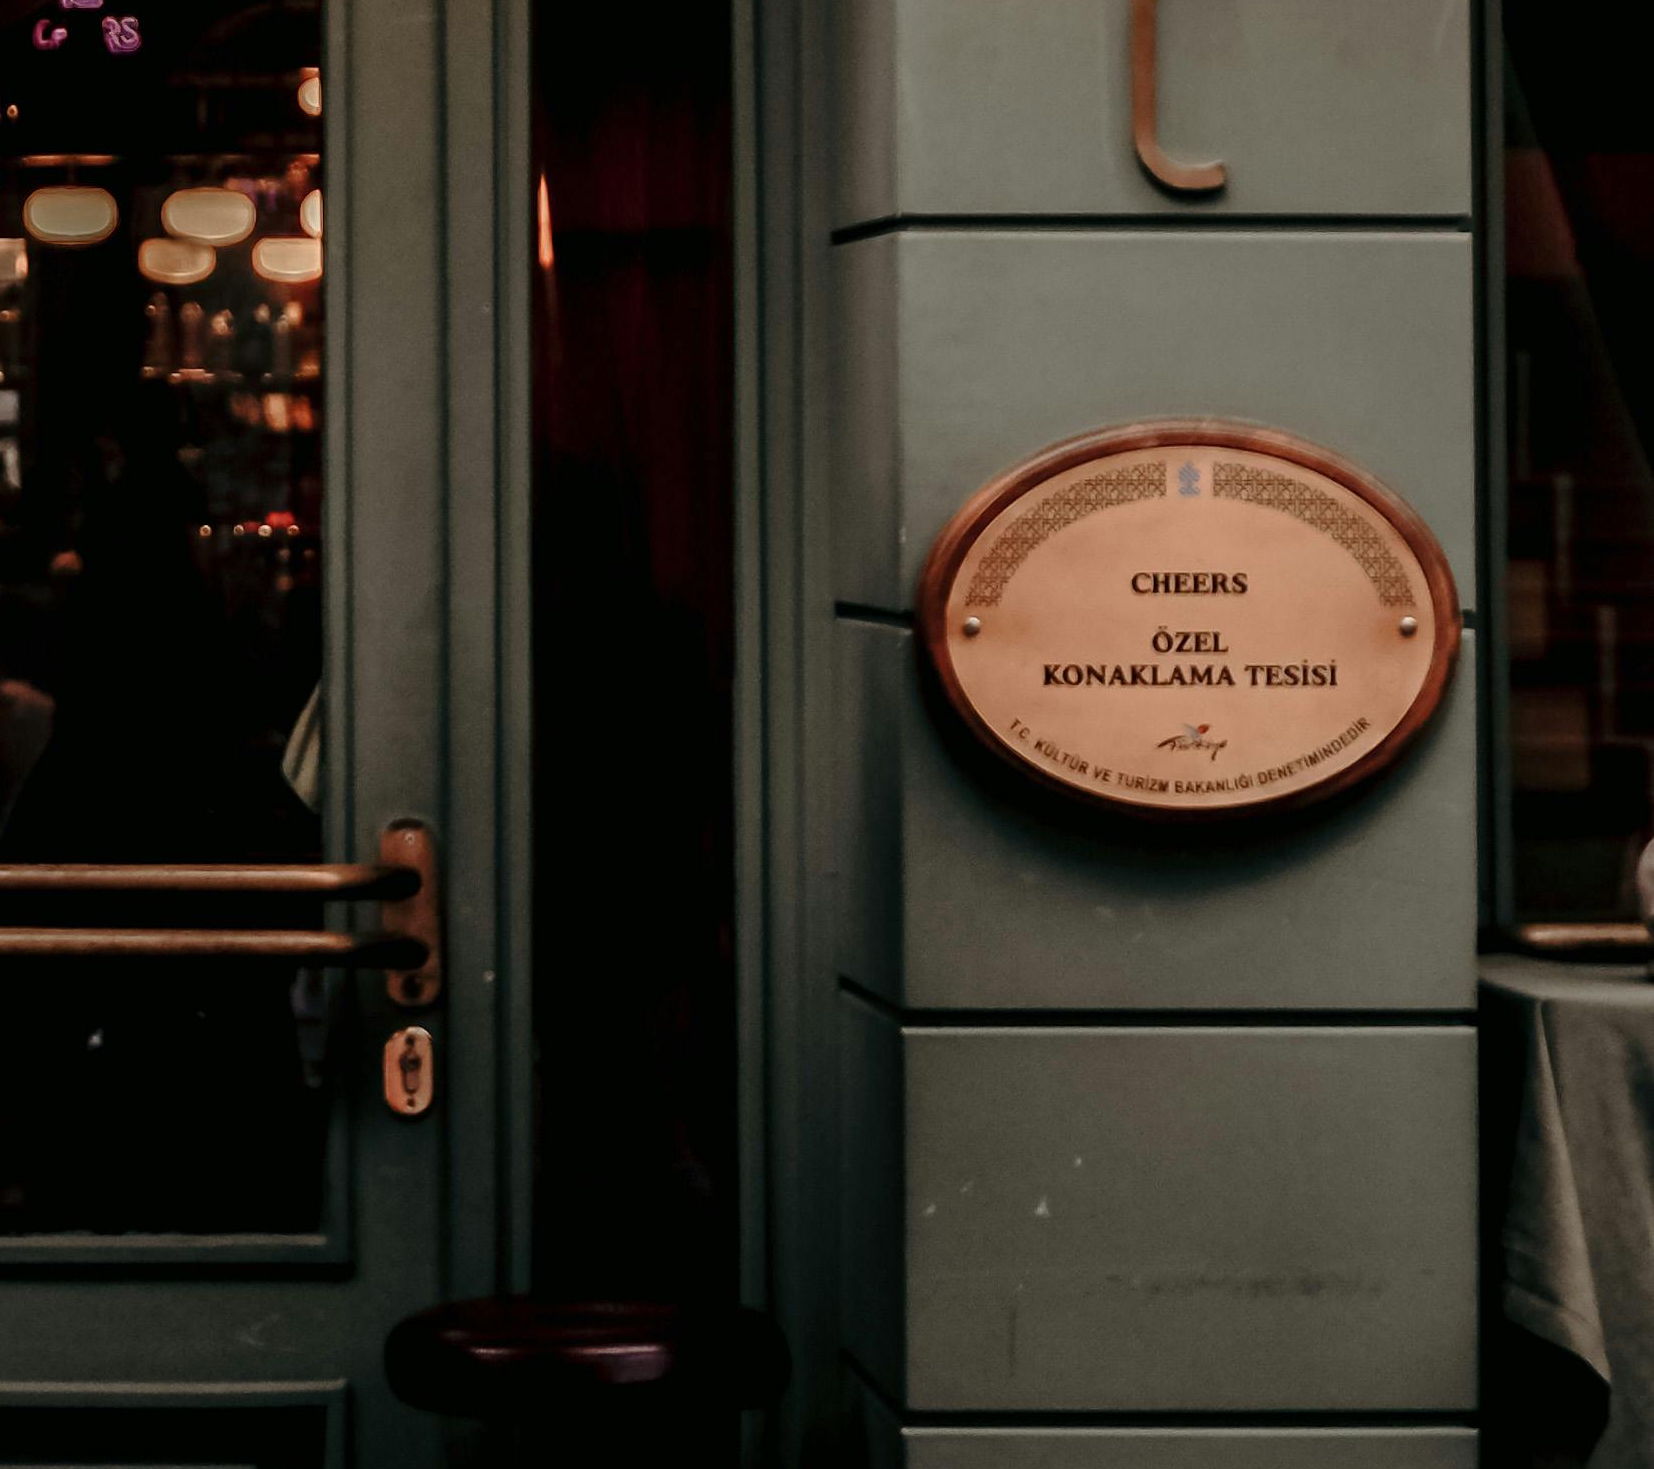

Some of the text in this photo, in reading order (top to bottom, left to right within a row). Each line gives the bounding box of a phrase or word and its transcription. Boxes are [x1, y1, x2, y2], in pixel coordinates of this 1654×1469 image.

[1131, 572, 1248, 595] CHEERS
[1152, 626, 1229, 654] ÖZEL
[1043, 659, 1338, 687] KONAKLAMA TESİSİ
[1034, 739, 1090, 775] KÜLTÜR
[1094, 766, 1112, 782] VE
[1118, 772, 1169, 793] TURİZM
